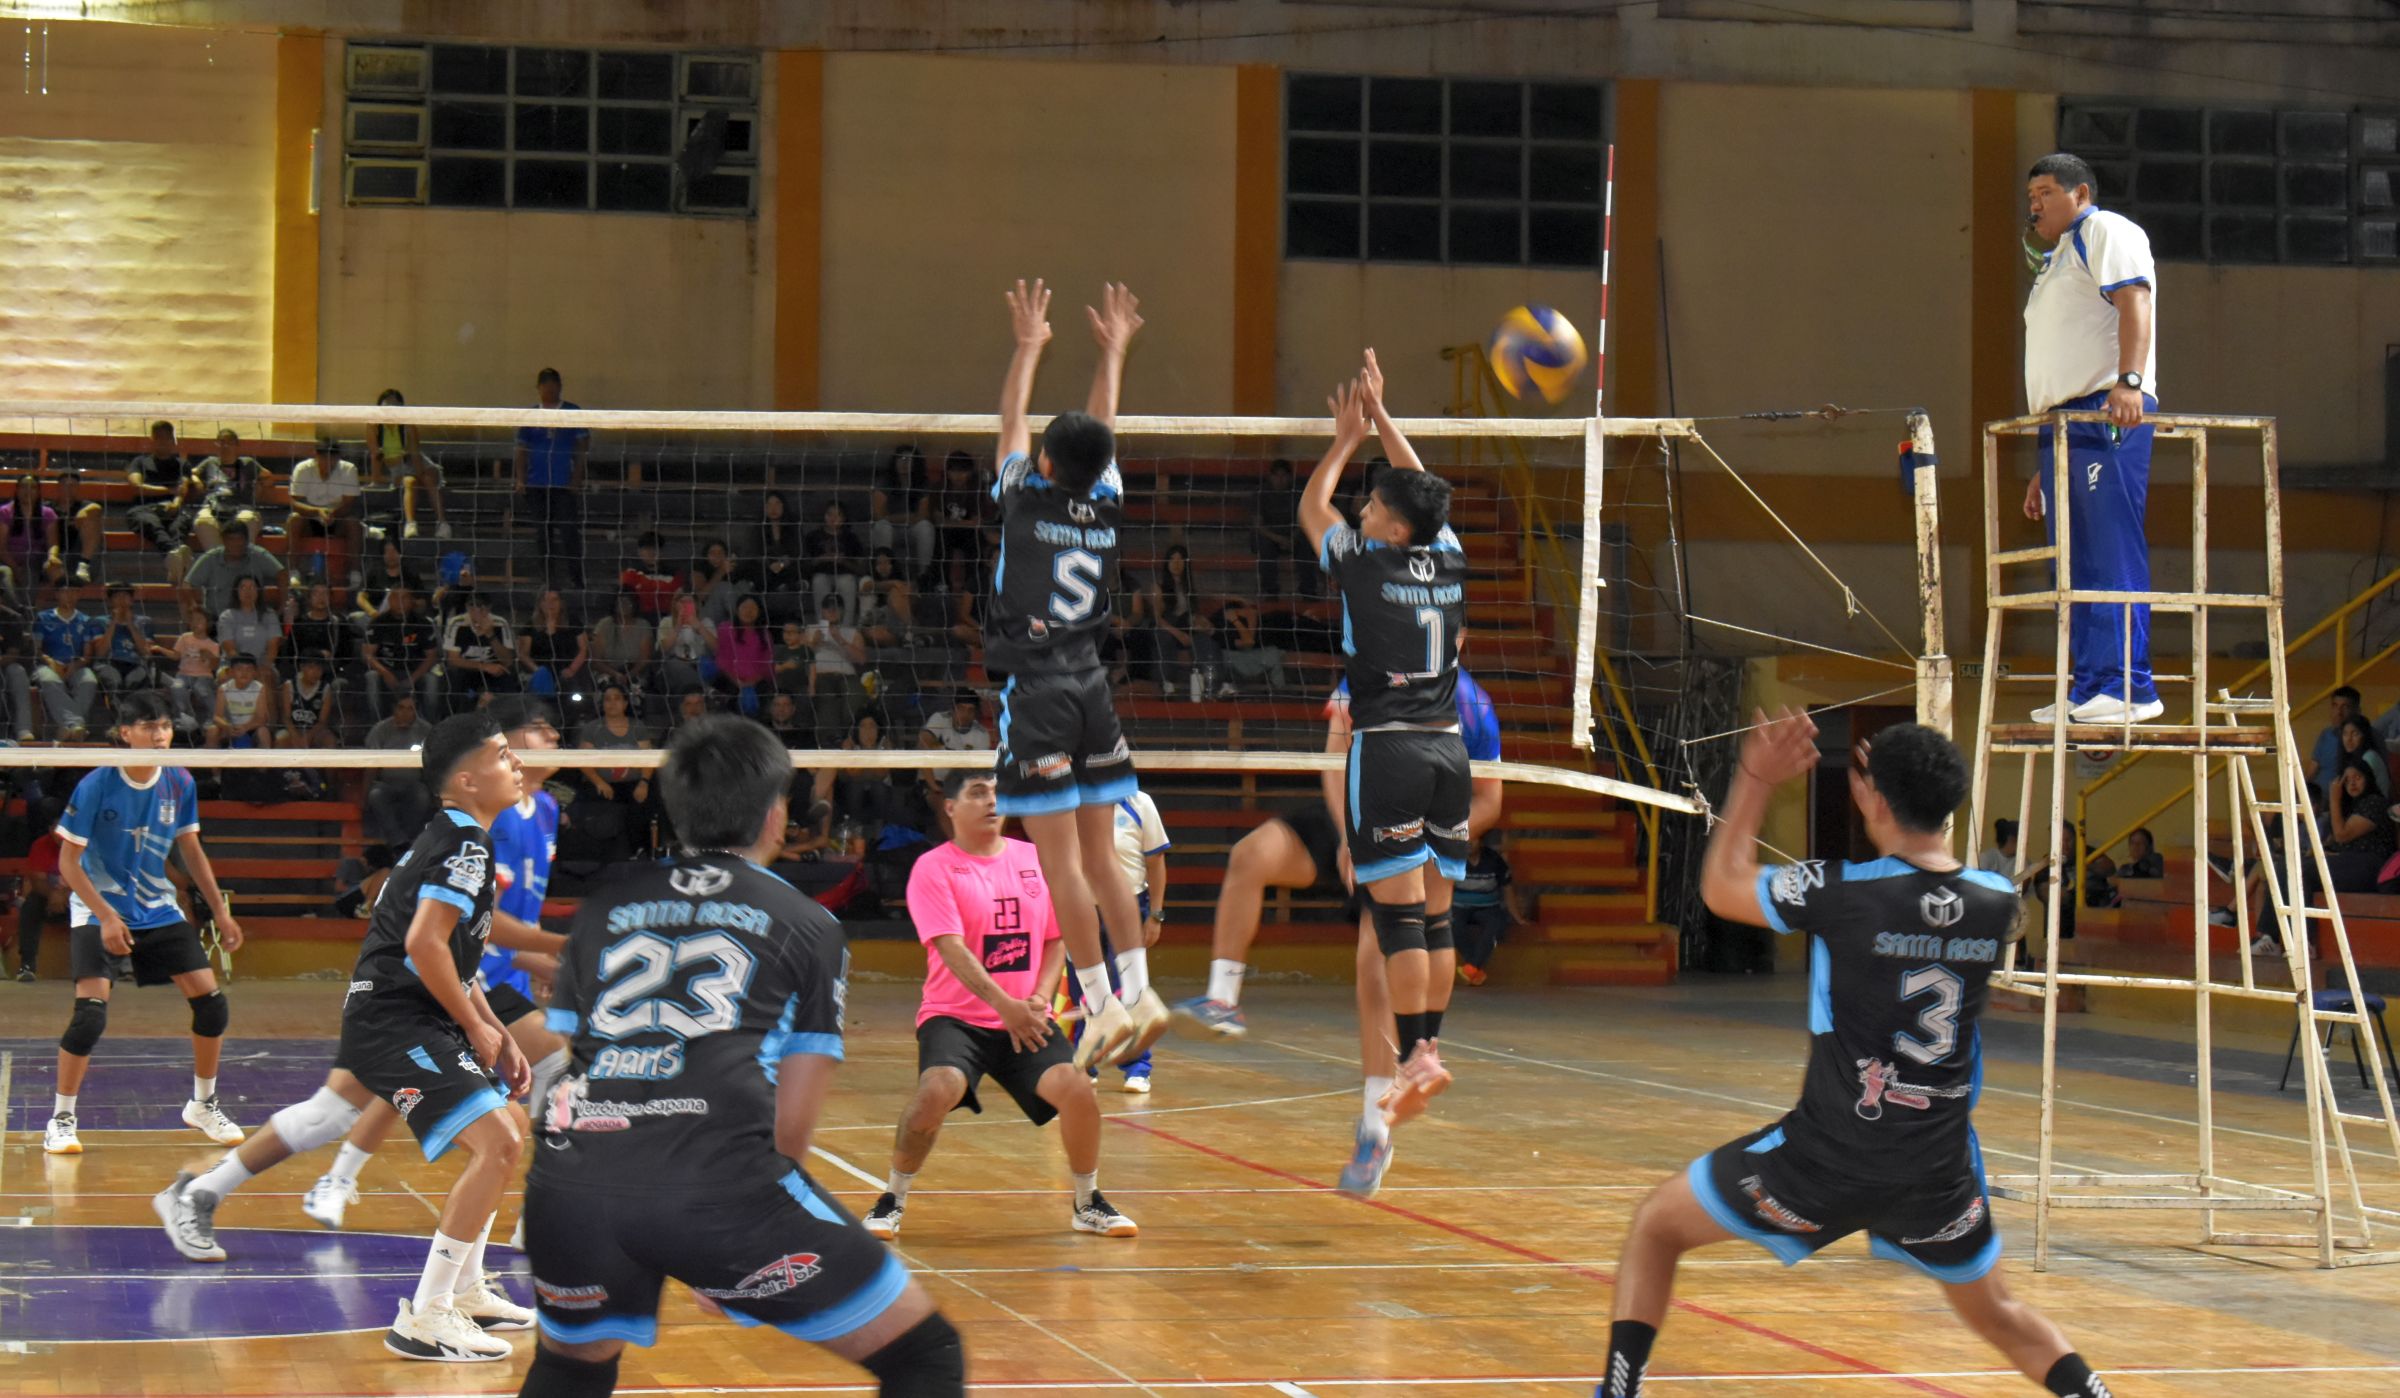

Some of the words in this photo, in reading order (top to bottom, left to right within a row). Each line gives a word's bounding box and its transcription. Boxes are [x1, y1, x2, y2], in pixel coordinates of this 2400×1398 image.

[1049, 547, 1102, 623] 5
[1415, 605, 1444, 672] 1
[607, 900, 695, 935] SANTA
[695, 901, 773, 938] ROSA
[994, 897, 1021, 930] 23
[1873, 931, 1943, 959] SANTA
[1947, 937, 1998, 962] ROSA
[589, 929, 759, 1040] 23
[1895, 962, 1965, 1065] 3
[576, 1099, 644, 1116] Verónica
